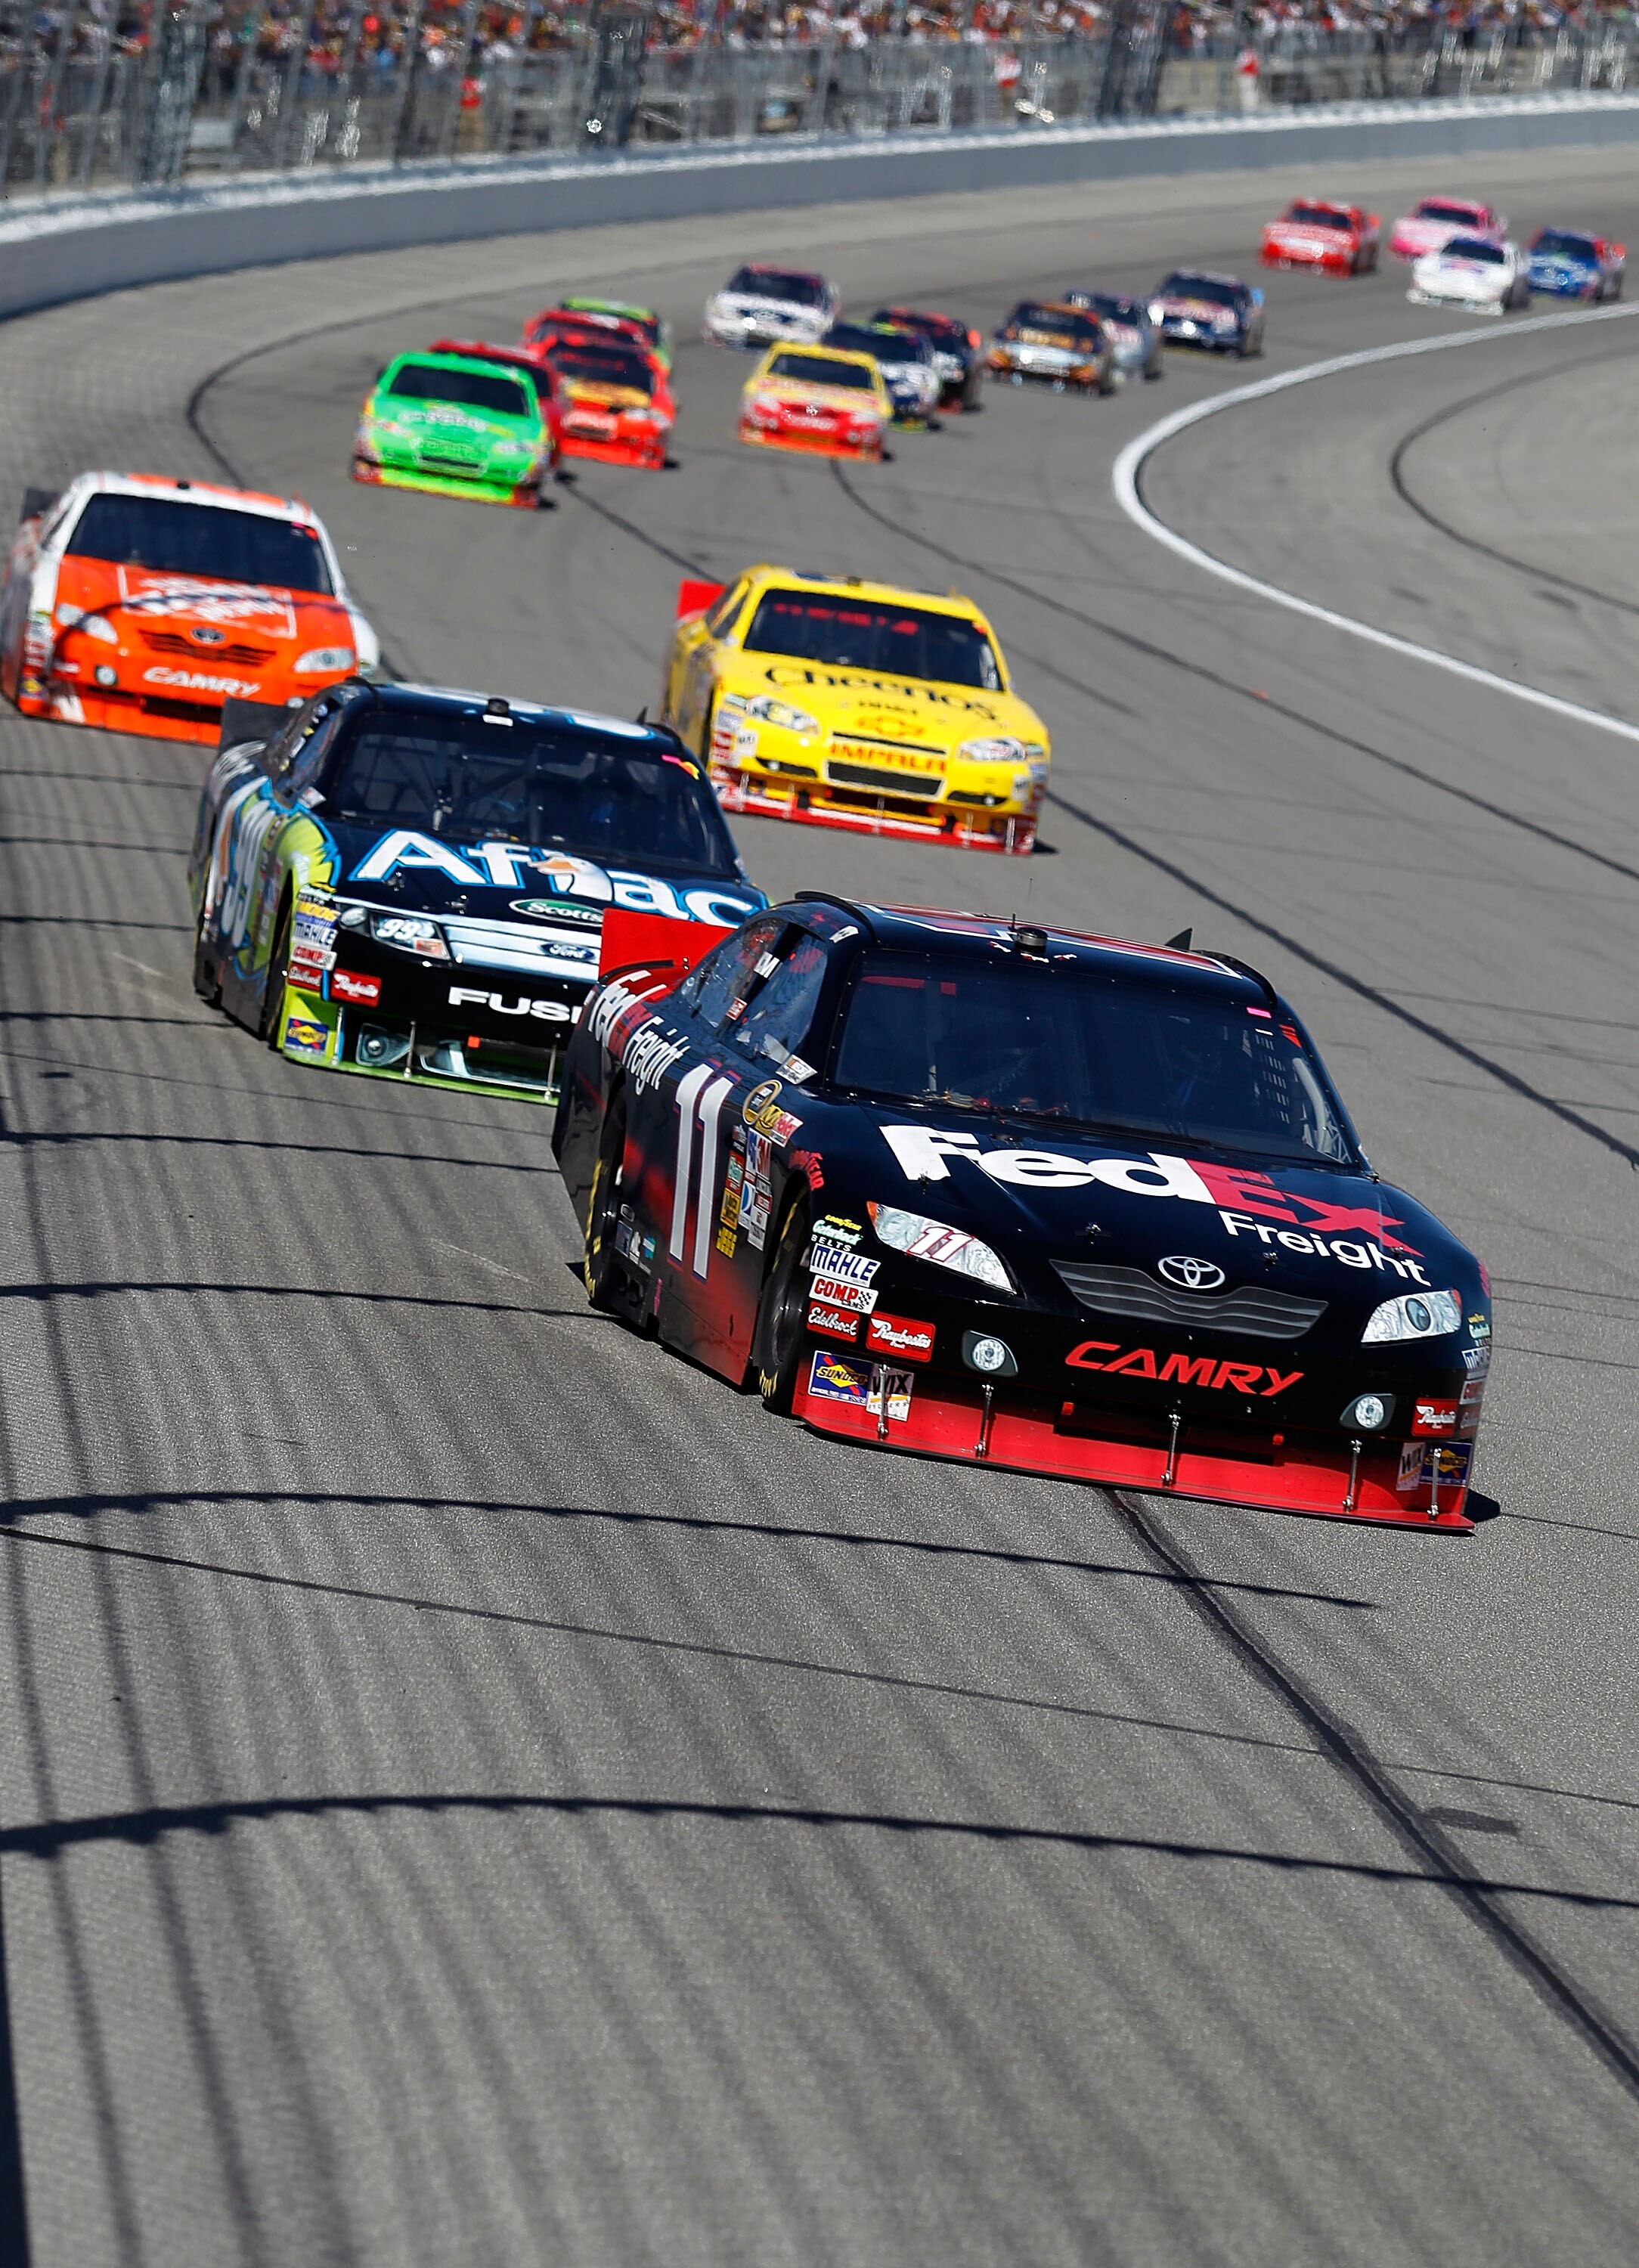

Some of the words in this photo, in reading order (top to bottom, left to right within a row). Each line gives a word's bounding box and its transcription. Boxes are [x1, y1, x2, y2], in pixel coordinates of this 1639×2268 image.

[142, 666, 262, 697] CAMRY
[527, 902, 603, 922] Scotts
[549, 944, 587, 959] Ford
[448, 986, 583, 1024] FUSI
[668, 1060, 741, 1282] 11
[879, 1125, 1425, 1257] FedEx
[810, 1234, 852, 1252] BELTS
[906, 1225, 975, 1263] 11
[1218, 1210, 1432, 1287] Freight
[812, 1246, 878, 1281] MAHLE
[814, 1278, 859, 1302] COMP
[818, 1366, 867, 1384] SUNOCO
[872, 1372, 912, 1396] WIX
[1065, 1341, 1304, 1396] CAMRY
